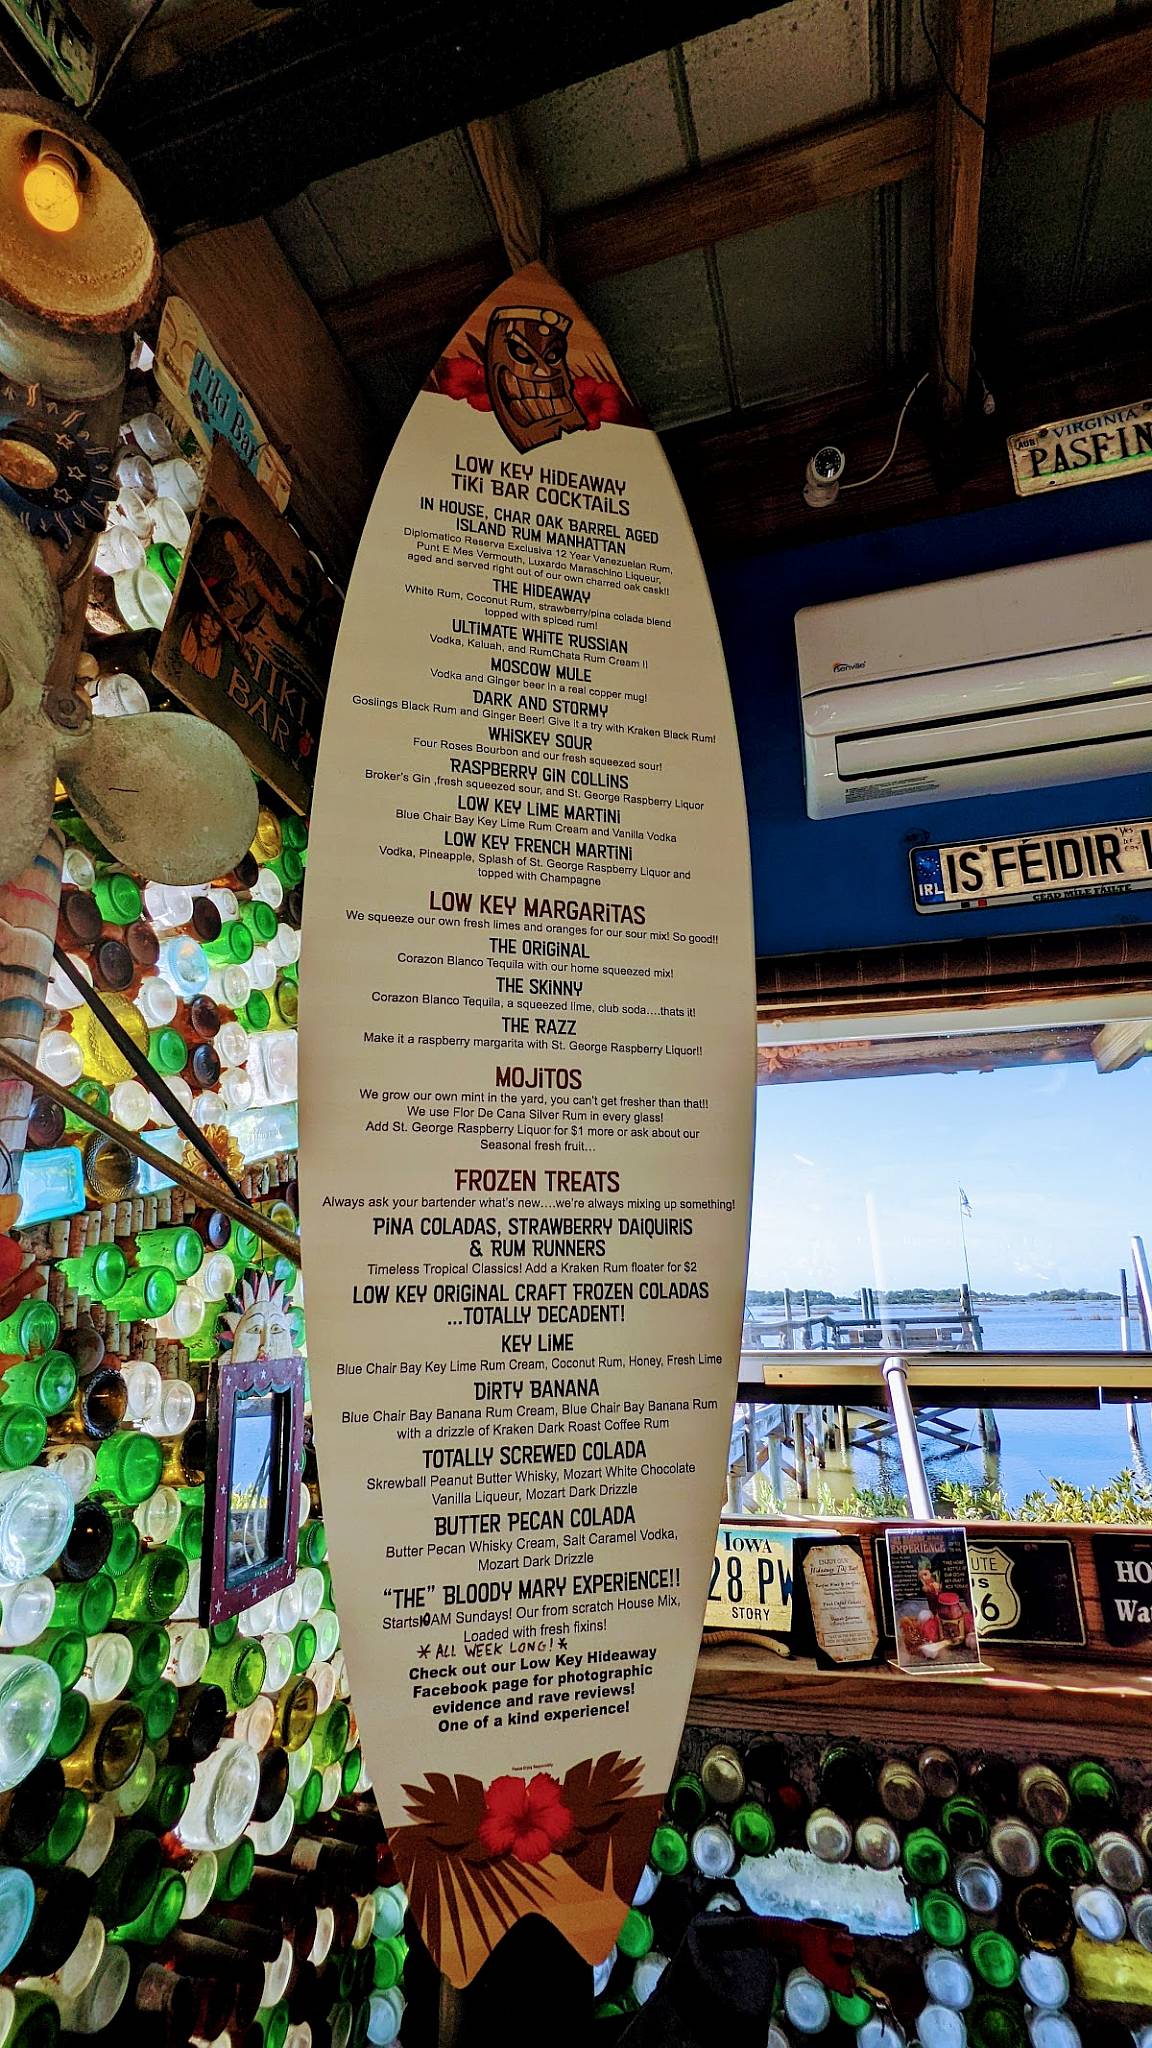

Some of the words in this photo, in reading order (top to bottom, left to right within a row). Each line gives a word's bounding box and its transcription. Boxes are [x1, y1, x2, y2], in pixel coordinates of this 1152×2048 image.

[195, 357, 230, 420] Tiki
[1052, 408, 1138, 438] VIRGINIA
[455, 453, 493, 475] LOW
[500, 461, 533, 481] KEY
[492, 479, 529, 500] BAR
[420, 496, 433, 511] IN
[439, 499, 488, 520] HOUSE,
[493, 507, 530, 525] CHAR
[535, 513, 563, 530] OAK
[567, 518, 620, 539] BARREL
[625, 527, 659, 544] AGED
[456, 517, 506, 536] ISLAND
[512, 525, 541, 542] RUM
[546, 530, 625, 555] MANHATTAN
[492, 578, 518, 594] THE
[484, 607, 518, 619] topped
[520, 613, 540, 622] with
[542, 615, 573, 626] spiced
[576, 620, 597, 630] rum!
[490, 657, 550, 677] MOSCOW
[556, 665, 591, 682] MULE
[252, 644, 308, 727] TIKI
[227, 666, 290, 752] BAR
[473, 689, 512, 707] DARK
[517, 695, 547, 711] AND
[552, 698, 608, 718] STORMY
[413, 737, 437, 748] Four
[440, 739, 473, 751] Roses
[476, 743, 518, 756] Bourbon
[521, 750, 540, 758] and
[542, 752, 559, 760] our
[562, 752, 586, 763] fresh
[589, 757, 635, 768] squeezed
[638, 762, 662, 771] sour!
[555, 733, 592, 750] SOUR
[451, 757, 537, 780] RASPBERRY
[396, 808, 419, 819] Blue
[422, 811, 451, 822] Chair
[454, 813, 474, 826] Bay
[477, 815, 497, 828] Key
[500, 817, 525, 829] Lime
[528, 820, 551, 831] Rum
[555, 822, 588, 834] Cream
[591, 827, 609, 836] and
[612, 828, 644, 839] Vanilla
[646, 831, 677, 842] Vodka
[946, 850, 984, 894] IS
[429, 890, 471, 912] LOW
[480, 894, 516, 915] KEY
[919, 882, 944, 897] IRL
[502, 1016, 529, 1033] THE
[534, 1018, 577, 1035] RAZZ
[407, 1105, 425, 1116] We
[429, 1108, 449, 1117] use
[453, 1106, 474, 1117] Flor
[477, 1107, 493, 1118] De
[496, 1108, 525, 1119] Cana
[529, 1108, 559, 1119] Silver
[562, 1109, 587, 1120] Rum
[590, 1110, 599, 1120] in
[602, 1113, 631, 1124] every
[633, 1112, 663, 1124] glass!
[454, 1168, 536, 1191] FROZEN
[544, 1170, 619, 1192] TREATS
[469, 1239, 482, 1257] &
[490, 1239, 525, 1257] RUM
[532, 1239, 605, 1257] RUNNERS
[367, 1263, 419, 1275] Timeless
[422, 1263, 468, 1276] Tropical
[471, 1262, 522, 1274] Classics!
[524, 1262, 546, 1273] Add
[550, 1264, 557, 1273] a
[560, 1261, 599, 1273] Kraken
[603, 1261, 628, 1272] Rum
[631, 1261, 664, 1272] floater
[666, 1261, 681, 1272] for
[683, 1260, 697, 1273] $2
[539, 1304, 624, 1323] DECADENT!
[423, 1446, 493, 1468] TOTALLY
[499, 1443, 576, 1465] SCREWED
[582, 1439, 646, 1461] COLADA
[366, 1475, 426, 1490] Skrewball
[430, 1473, 473, 1487] Peanut
[476, 1472, 512, 1484] Butter
[514, 1469, 559, 1483] Whisky,
[563, 1467, 602, 1480] Mozart
[605, 1464, 637, 1477] White
[640, 1461, 695, 1476] Chocolate
[434, 1513, 500, 1536] BUTTER
[507, 1509, 563, 1532] PECAN
[570, 1505, 635, 1527] COLADA
[970, 1557, 998, 1571] UTE
[1114, 1560, 1152, 1584] HO
[444, 1580, 512, 1605] BLOODY
[518, 1576, 566, 1599] MARY
[732, 1606, 770, 1621] STORY
[1114, 1599, 1152, 1624] Wa
[435, 1643, 456, 1659] ALL
[464, 1642, 503, 1657] WEEK
[509, 1637, 553, 1653] LONG!
[408, 1664, 457, 1680] Check
[461, 1662, 486, 1675] out
[491, 1661, 516, 1672] our
[520, 1657, 550, 1670] Low
[555, 1653, 583, 1668] Key
[587, 1648, 656, 1663] Hideaway
[413, 1679, 487, 1698] Facebook
[492, 1678, 528, 1693] page
[532, 1673, 553, 1686] for
[558, 1663, 652, 1687] photographic
[432, 1698, 501, 1714] evidence
[506, 1692, 533, 1707] and
[538, 1692, 569, 1704] rave
[574, 1682, 634, 1700] reviews!
[438, 1719, 468, 1732] One
[473, 1715, 489, 1729] of
[493, 1717, 502, 1727] a
[507, 1709, 539, 1725] kind
[543, 1700, 629, 1722] experience!
